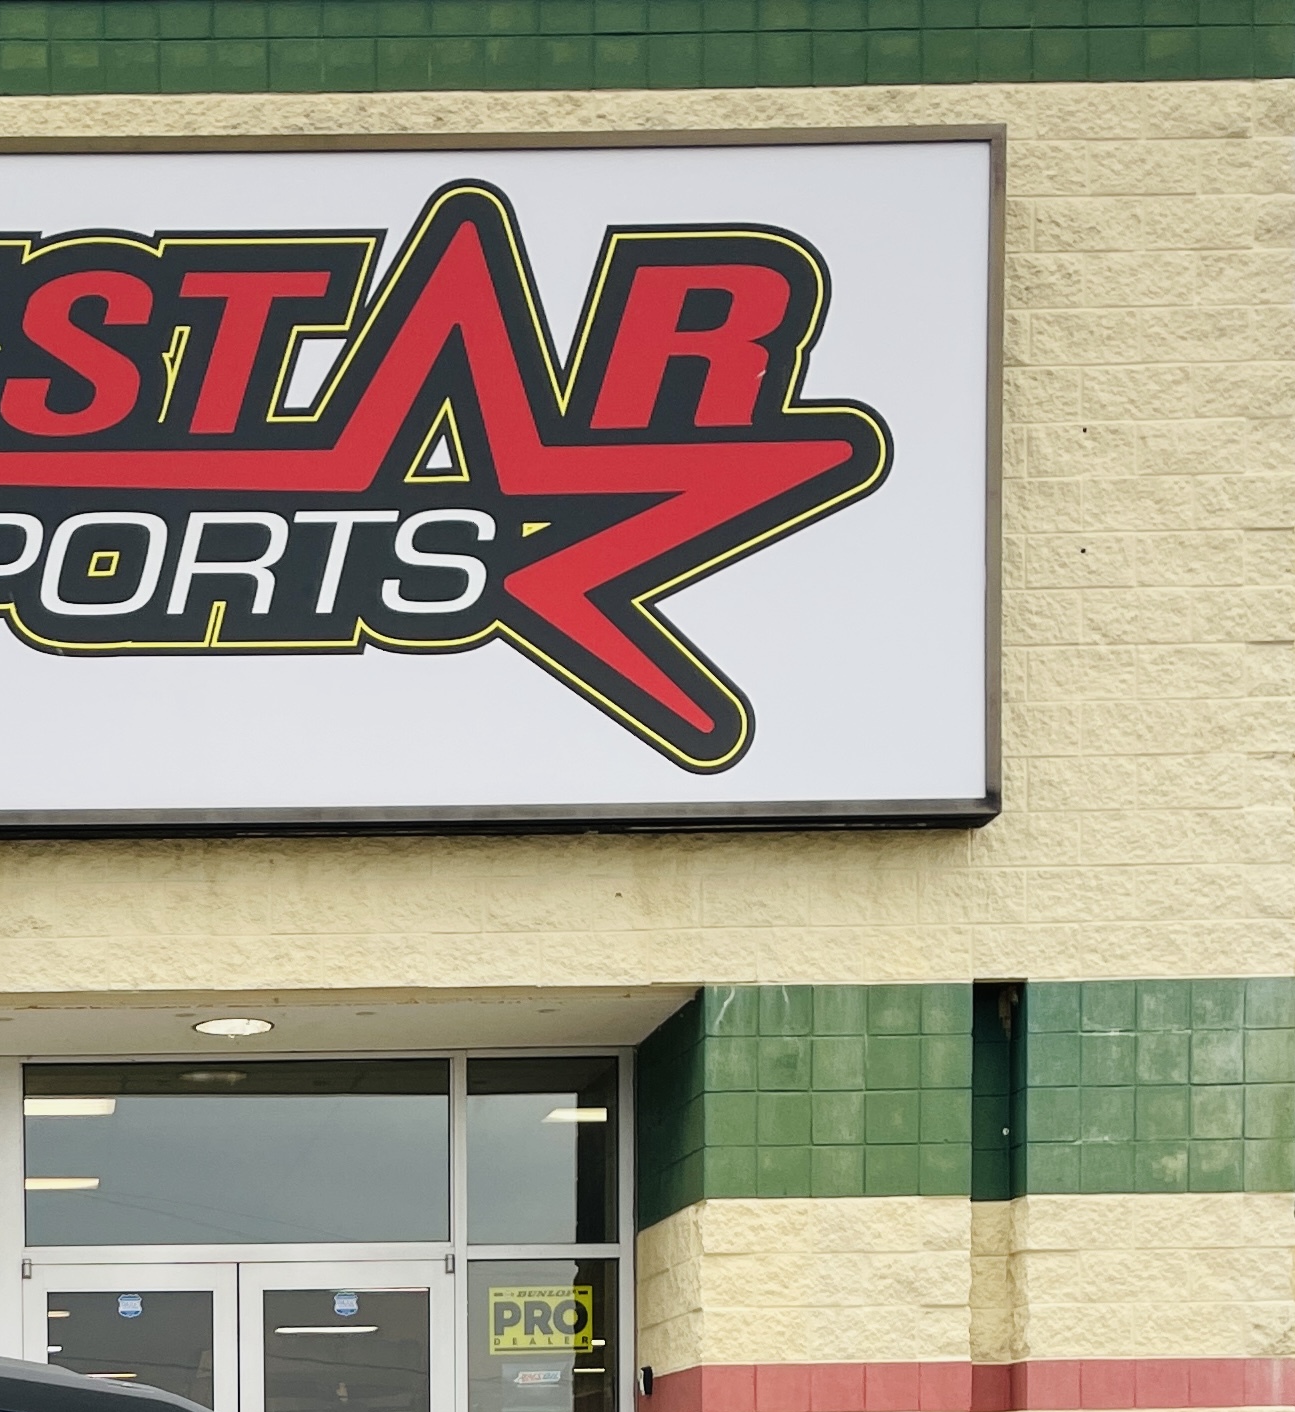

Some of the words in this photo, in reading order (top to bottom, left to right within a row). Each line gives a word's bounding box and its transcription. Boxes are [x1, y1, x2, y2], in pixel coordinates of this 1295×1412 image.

[516, 1289, 575, 1298] DUNLOP
[494, 1299, 588, 1335] PRO
[493, 1336, 589, 1346] DEALER
